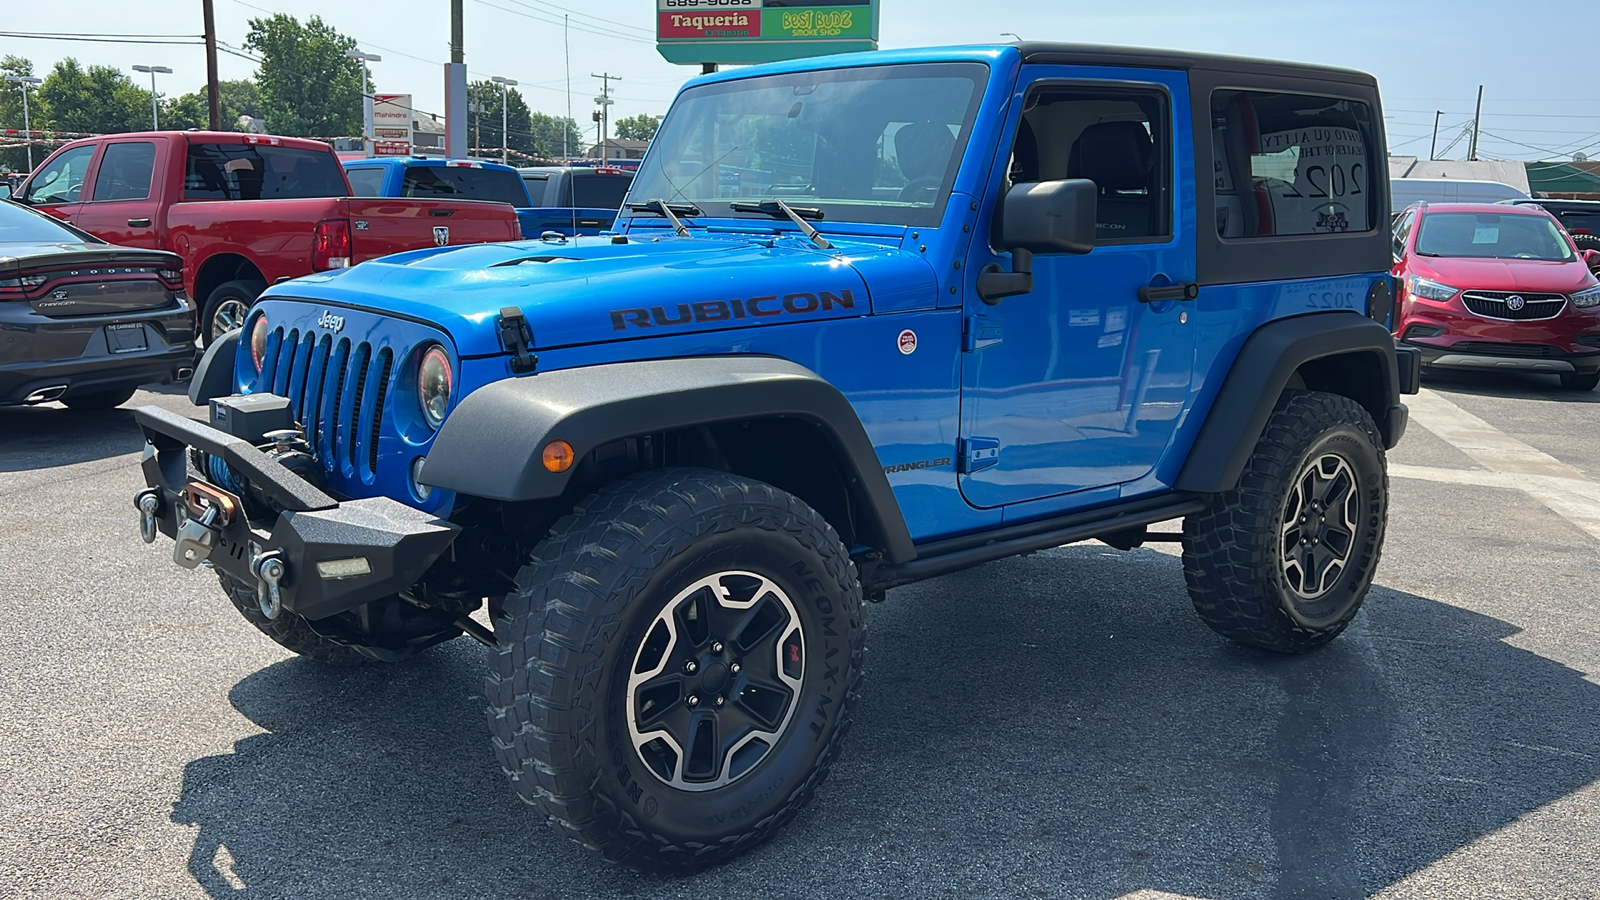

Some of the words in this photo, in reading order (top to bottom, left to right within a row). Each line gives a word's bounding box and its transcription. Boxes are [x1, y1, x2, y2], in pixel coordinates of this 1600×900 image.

[671, 12, 748, 30] Taquería
[820, 28, 841, 36] SHOP
[317, 310, 345, 335] Jeep
[608, 289, 856, 331] RUBICON
[787, 560, 840, 743] NEOMAX-MT
